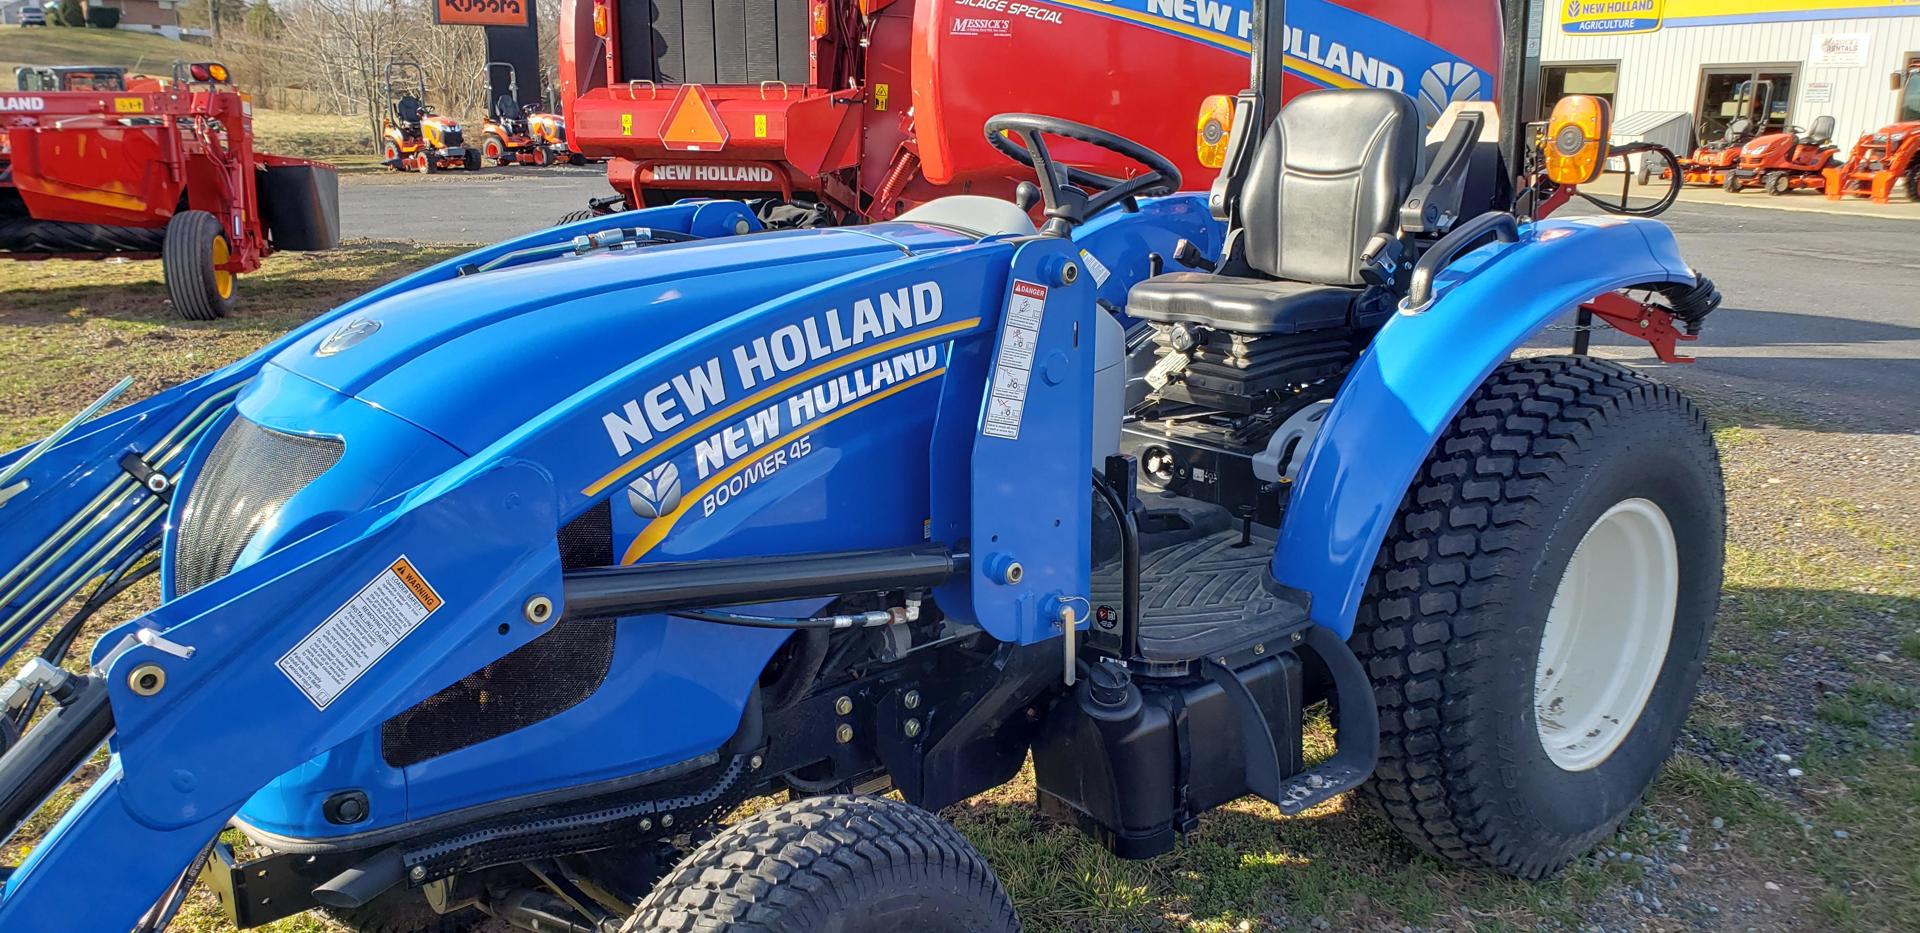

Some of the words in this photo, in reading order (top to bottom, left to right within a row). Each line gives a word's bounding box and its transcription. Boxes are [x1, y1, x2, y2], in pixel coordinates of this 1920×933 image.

[1007, 3, 1063, 24] SPECIAL
[1147, 0, 1232, 32] NEW
[1582, 3, 1605, 14] NEW
[1606, 0, 1654, 13] HOLLAND
[953, 18, 1010, 32] MESSICK'S
[1579, 19, 1635, 30] AGRICULTURE
[653, 165, 692, 180] NEW
[695, 167, 773, 182] HOLLAND
[1020, 285, 1045, 297] DANGER
[601, 356, 726, 458] NEW
[732, 280, 943, 391] HOLLAND
[694, 402, 780, 481] NEW
[787, 344, 937, 428] HOLLAND
[703, 447, 788, 518] BOOMER
[789, 434, 813, 462] 45
[390, 575, 409, 595] LOADER
[406, 592, 423, 611] SAFETY
[404, 572, 434, 606] WARNING
[349, 603, 374, 630] INSTALLING
[371, 627, 390, 647] LOADER
[360, 605, 384, 629] REMOVING
[380, 627, 390, 636] OR
